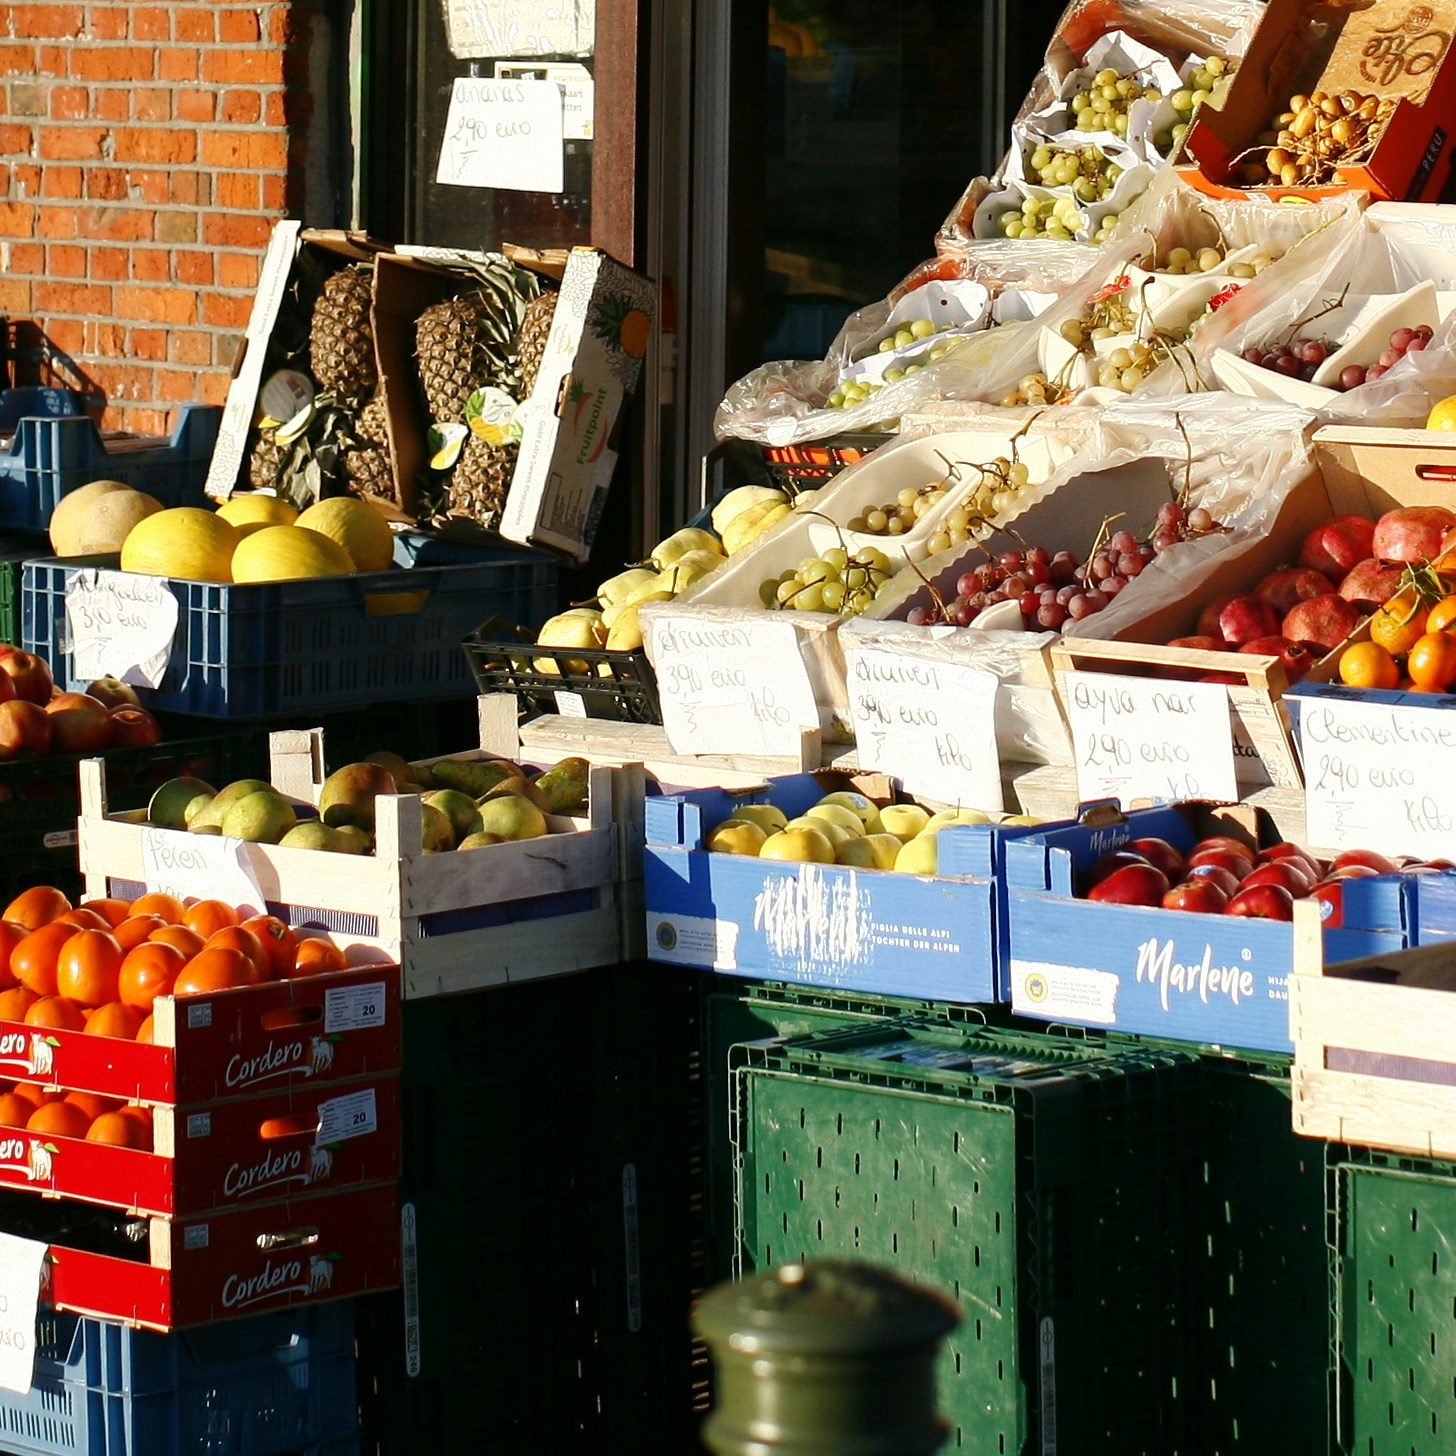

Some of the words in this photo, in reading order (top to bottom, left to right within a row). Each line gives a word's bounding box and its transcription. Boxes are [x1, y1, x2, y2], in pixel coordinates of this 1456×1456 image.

[495, 120, 532, 138] euro
[576, 387, 609, 466] Fruitpoint
[710, 666, 745, 689] euro
[899, 701, 938, 726] euro
[1073, 681, 1138, 726] ayva
[1152, 692, 1197, 715] nar
[1140, 742, 1190, 764] euro
[1367, 766, 1416, 789] euro
[1089, 830, 1131, 854] Marlene
[870, 921, 899, 934] FIGLIA
[901, 924, 928, 937] DELLE
[930, 927, 950, 939] ALPI
[871, 936, 911, 949] TOCHTER
[913, 939, 930, 951] DER
[932, 941, 960, 953] ALPEN
[1135, 937, 1254, 1012] Marlene
[361, 1003, 376, 1016] 20
[224, 1040, 304, 1087] Cordero
[352, 1111, 367, 1125] 20
[223, 1149, 302, 1197] Cordero
[221, 1258, 302, 1308] Cordero
